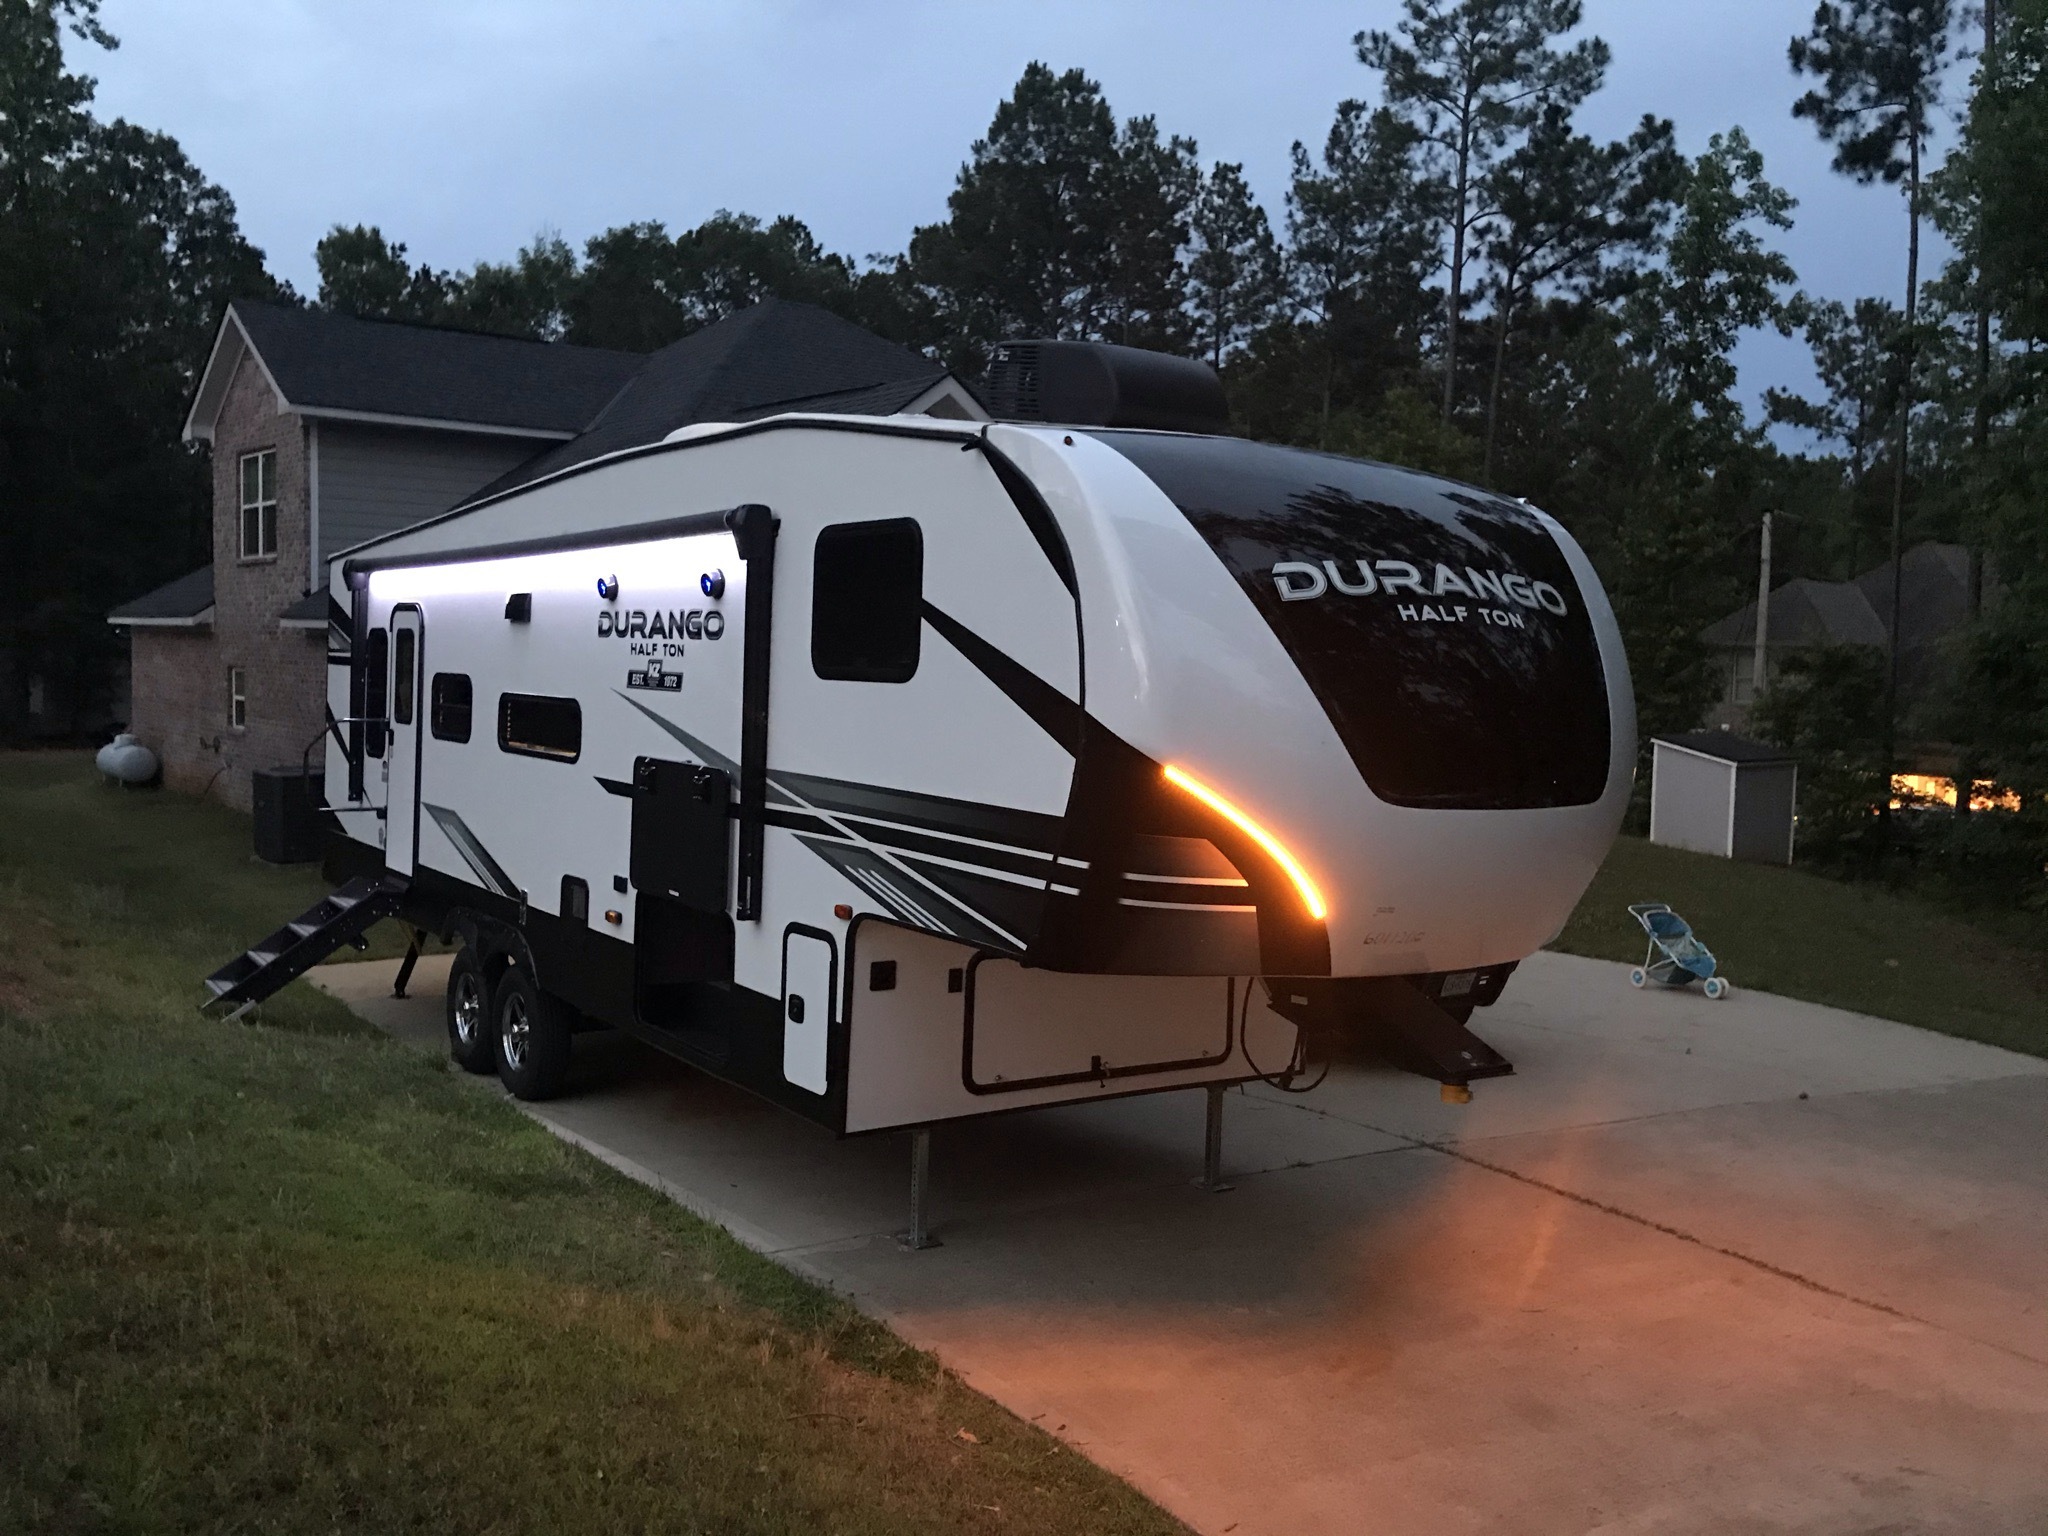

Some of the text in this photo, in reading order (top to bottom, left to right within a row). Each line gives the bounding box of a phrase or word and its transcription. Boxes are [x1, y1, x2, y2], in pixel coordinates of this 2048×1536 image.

[1271, 559, 1568, 617] DURANGO
[598, 609, 725, 641] DURANGO
[1397, 604, 1525, 629] HALF TON
[630, 643, 684, 657] HALF TON
[648, 663, 660, 678] KZ
